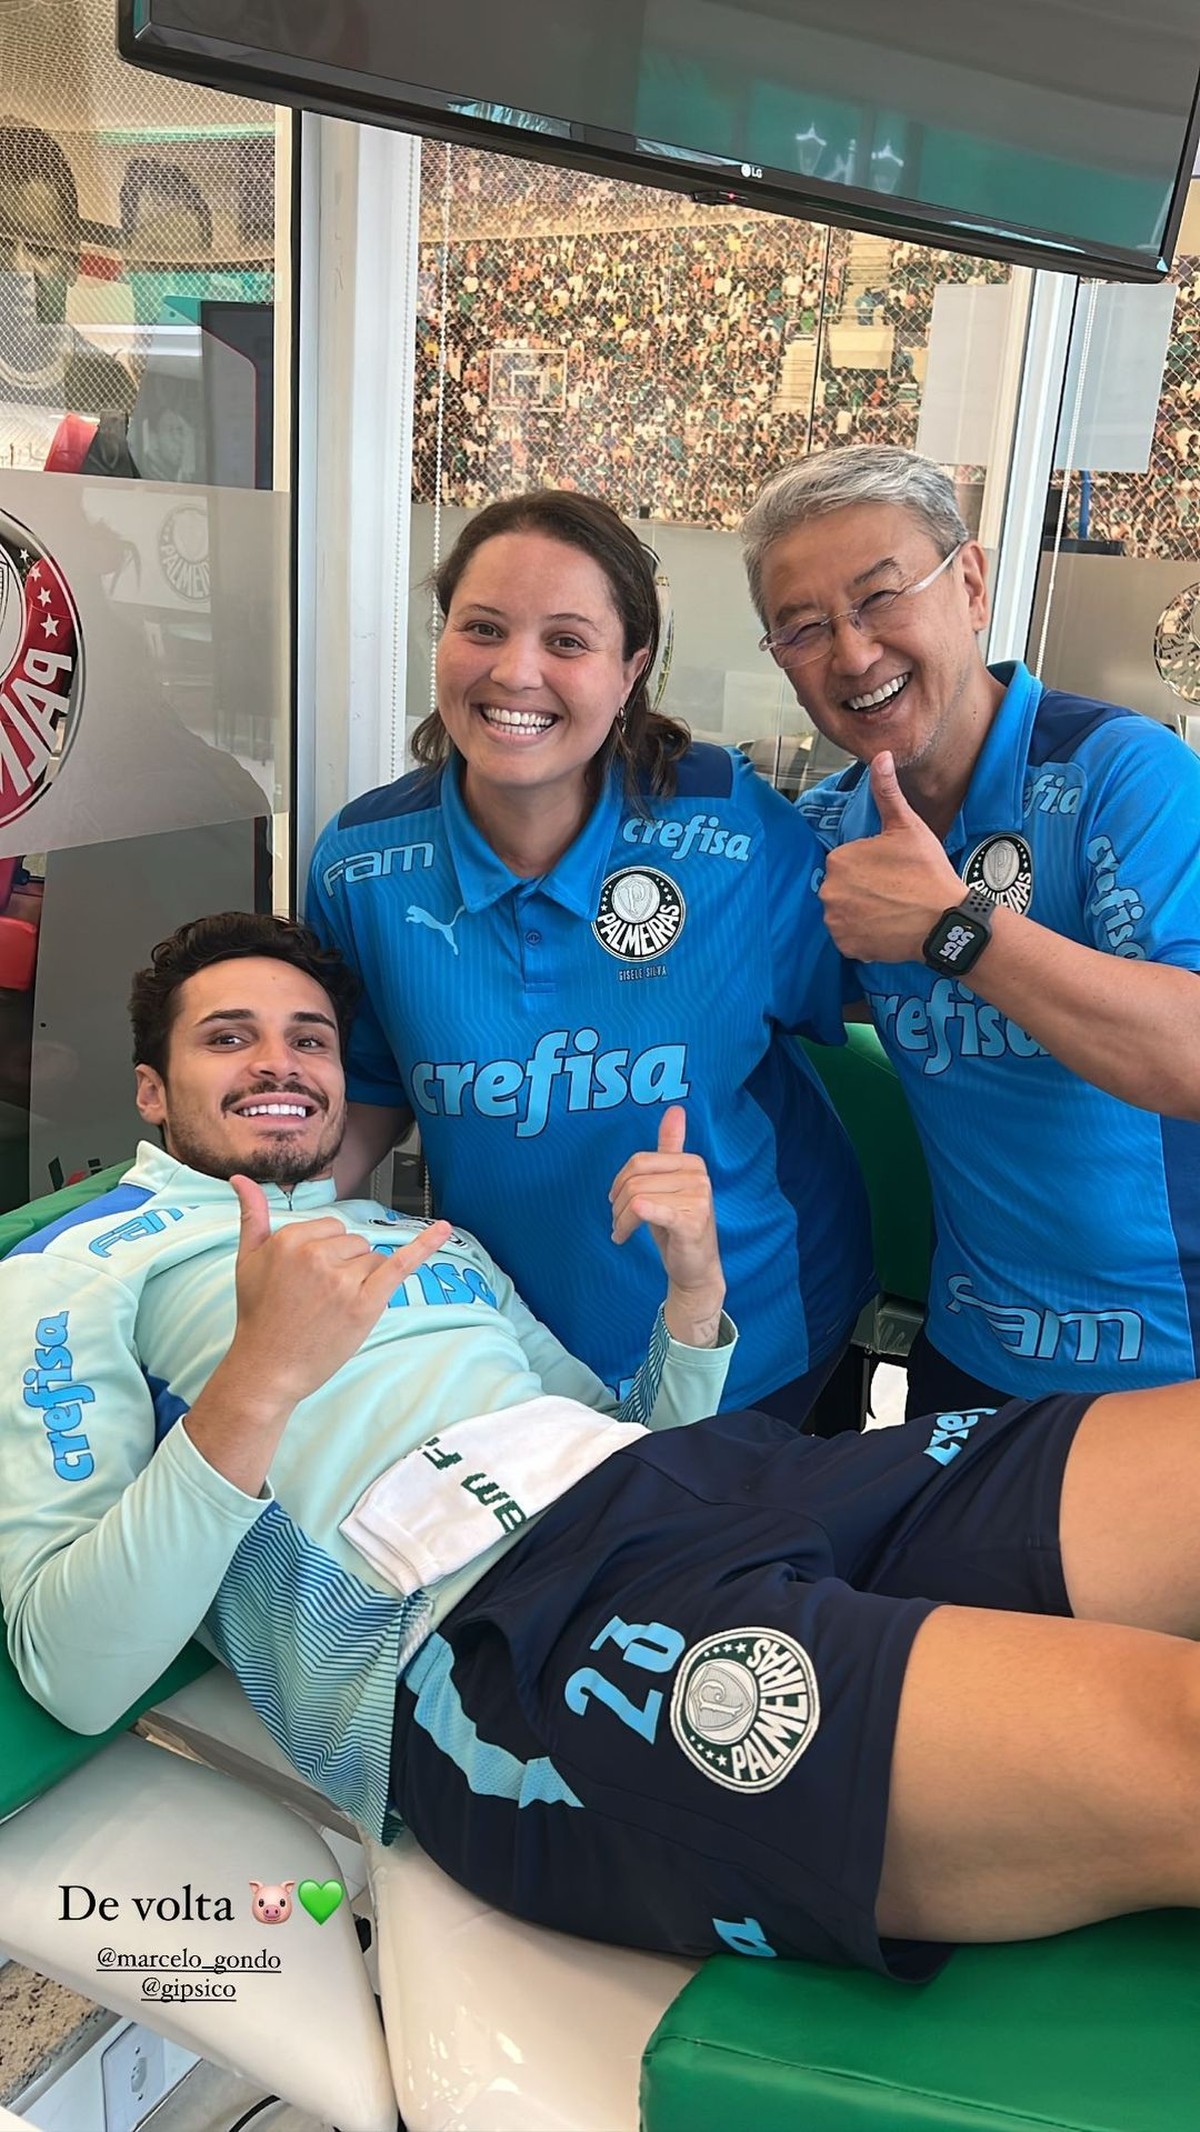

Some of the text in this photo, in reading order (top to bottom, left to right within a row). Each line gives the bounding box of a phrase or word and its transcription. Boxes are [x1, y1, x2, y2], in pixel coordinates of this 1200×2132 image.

[622, 814, 752, 862] crefisa
[597, 903, 680, 956] PALMEIRAS
[969, 872, 1031, 915] PEIRAS
[618, 965, 668, 982] GISELE SILVA
[411, 1027, 691, 1139] crefisa
[24, 1310, 95, 1482] crefisa
[564, 1614, 686, 1745] 23
[730, 1637, 809, 1781] PALMEIRAS
